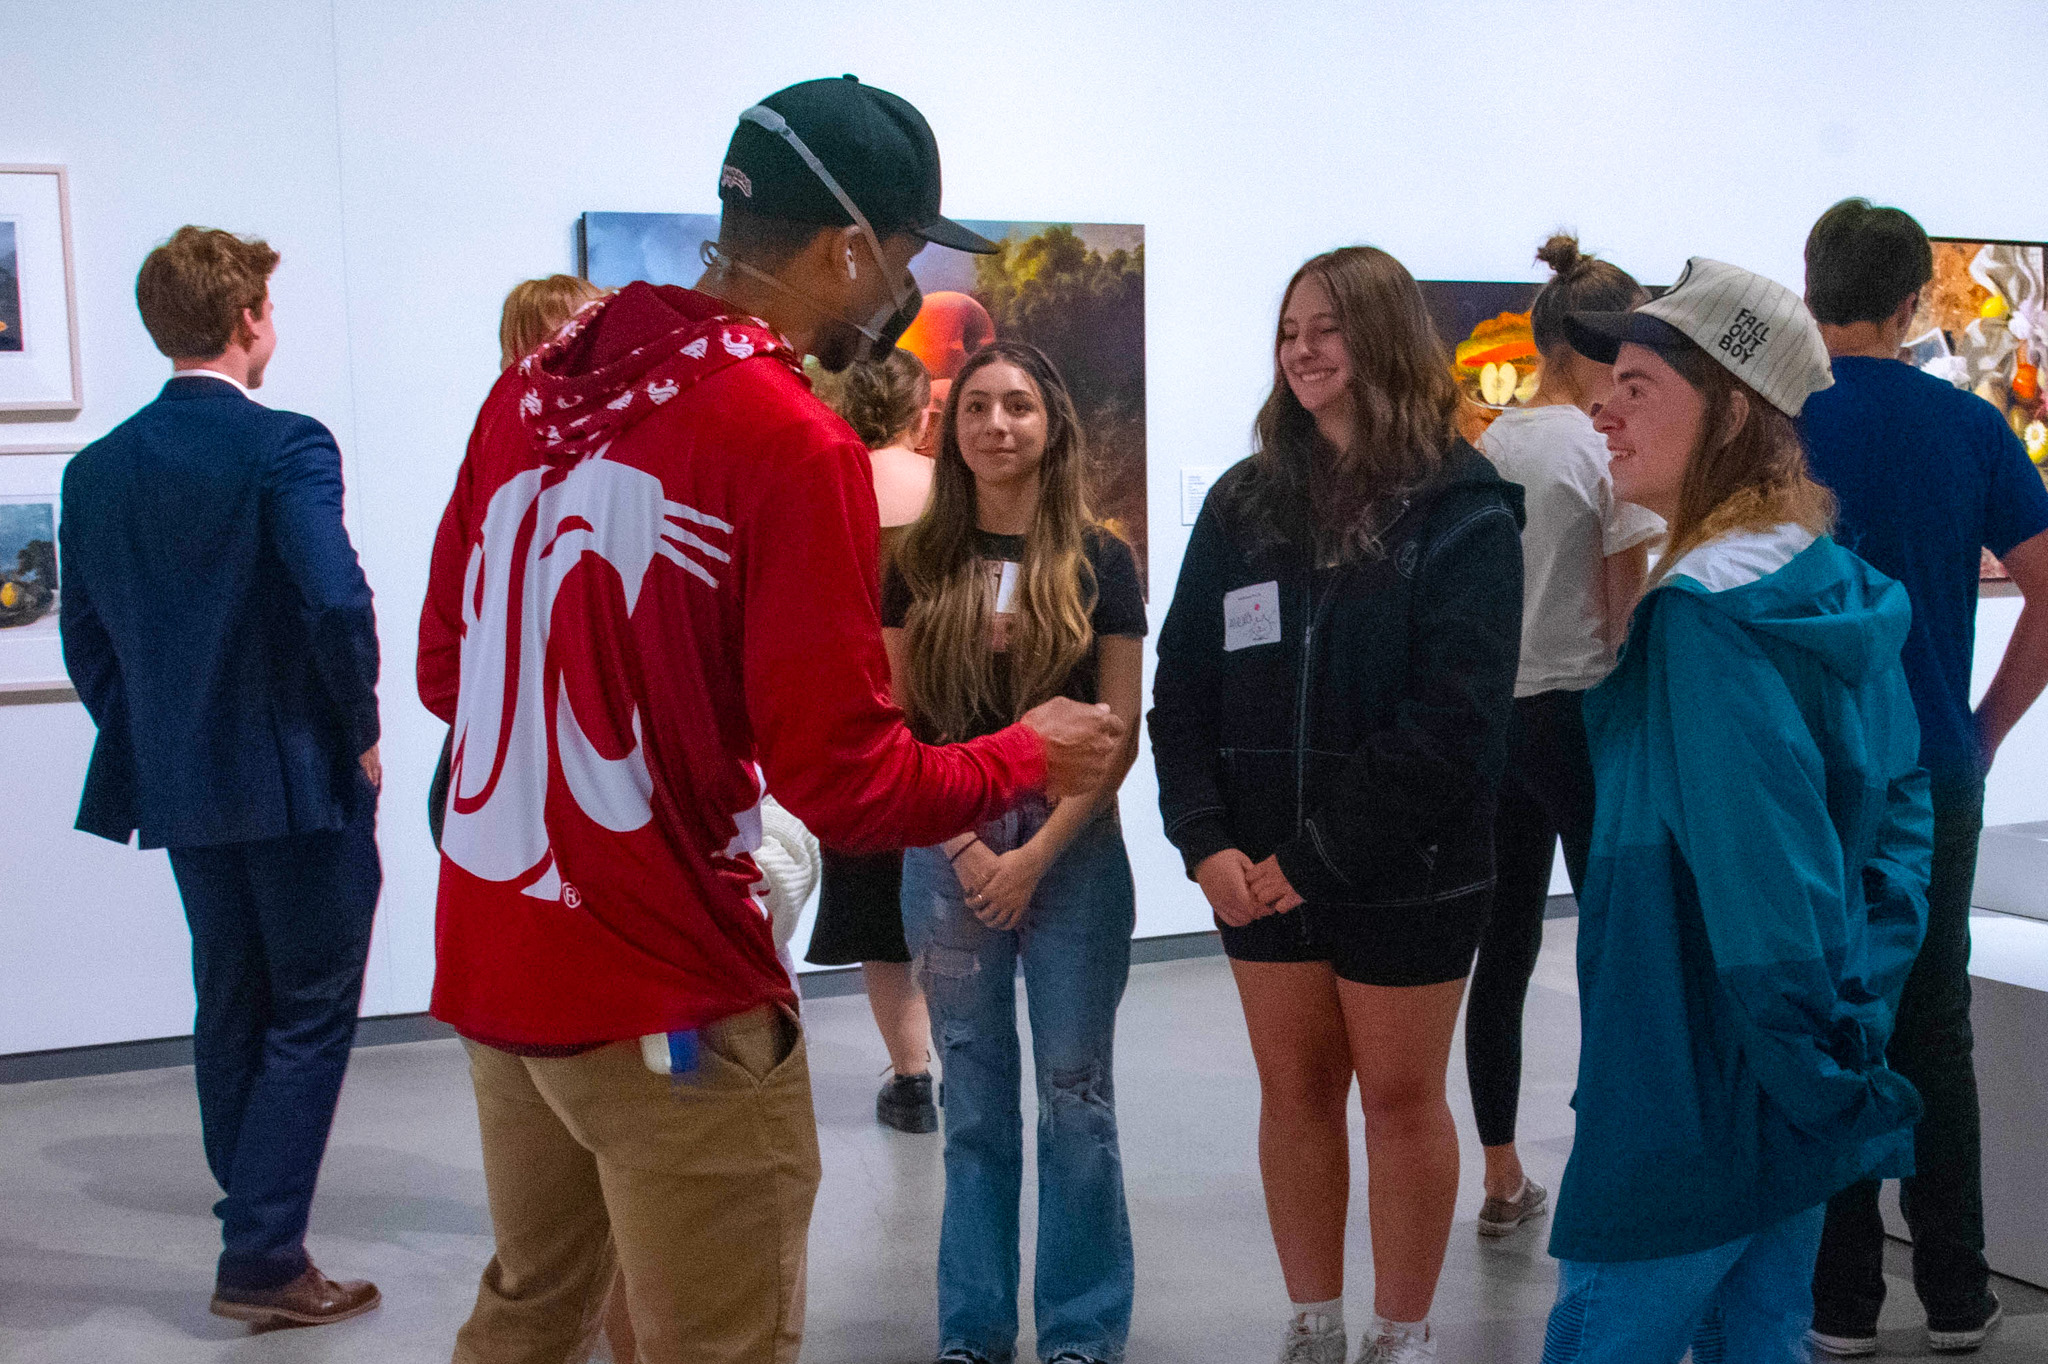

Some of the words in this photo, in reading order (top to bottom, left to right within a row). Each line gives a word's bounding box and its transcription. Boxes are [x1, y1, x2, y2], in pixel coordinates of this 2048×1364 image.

[1729, 324, 1763, 352] OUT
[1735, 308, 1770, 342] FALL
[1718, 335, 1754, 365] BOY
